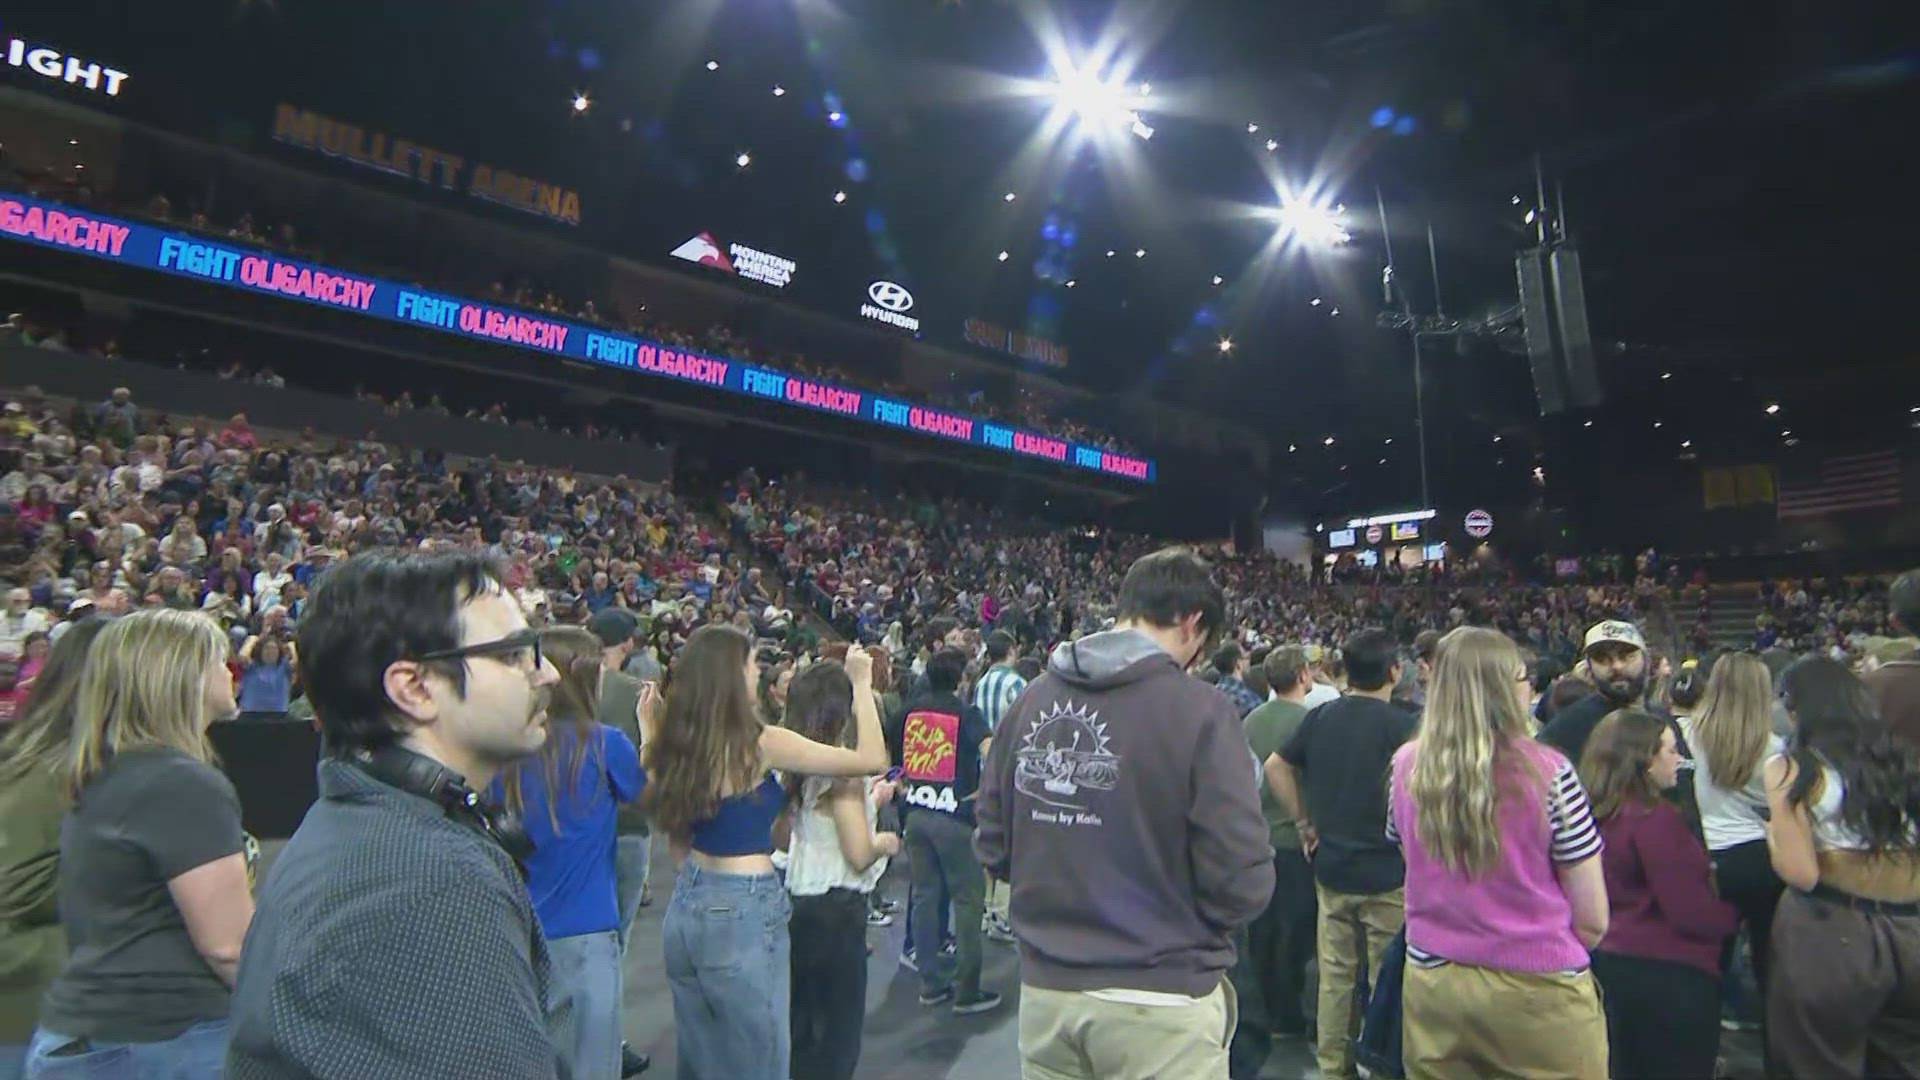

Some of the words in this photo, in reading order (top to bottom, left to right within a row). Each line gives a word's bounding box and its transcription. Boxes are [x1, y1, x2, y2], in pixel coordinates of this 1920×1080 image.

[0, 38, 129, 96] IGHT
[158, 236, 242, 282] FIGHT
[240, 256, 376, 310] OLIGARCHY
[396, 290, 461, 329] FIGHT
[459, 304, 569, 352] OLIGARCHY
[861, 303, 919, 331] HYUNDAI
[585, 332, 639, 367] FIGHT
[637, 345, 728, 386] OLIGARCHY
[743, 367, 785, 400] FIGHT
[785, 378, 861, 415] OLIGARCHY
[873, 399, 910, 427] FIGHT
[909, 406, 973, 441] OLIGARCHY
[983, 423, 1014, 450] FIGHT
[1013, 432, 1067, 462] OLIGARCHY
[1075, 447, 1102, 470] FIGHT
[1101, 454, 1148, 479] OLIGARCHY
